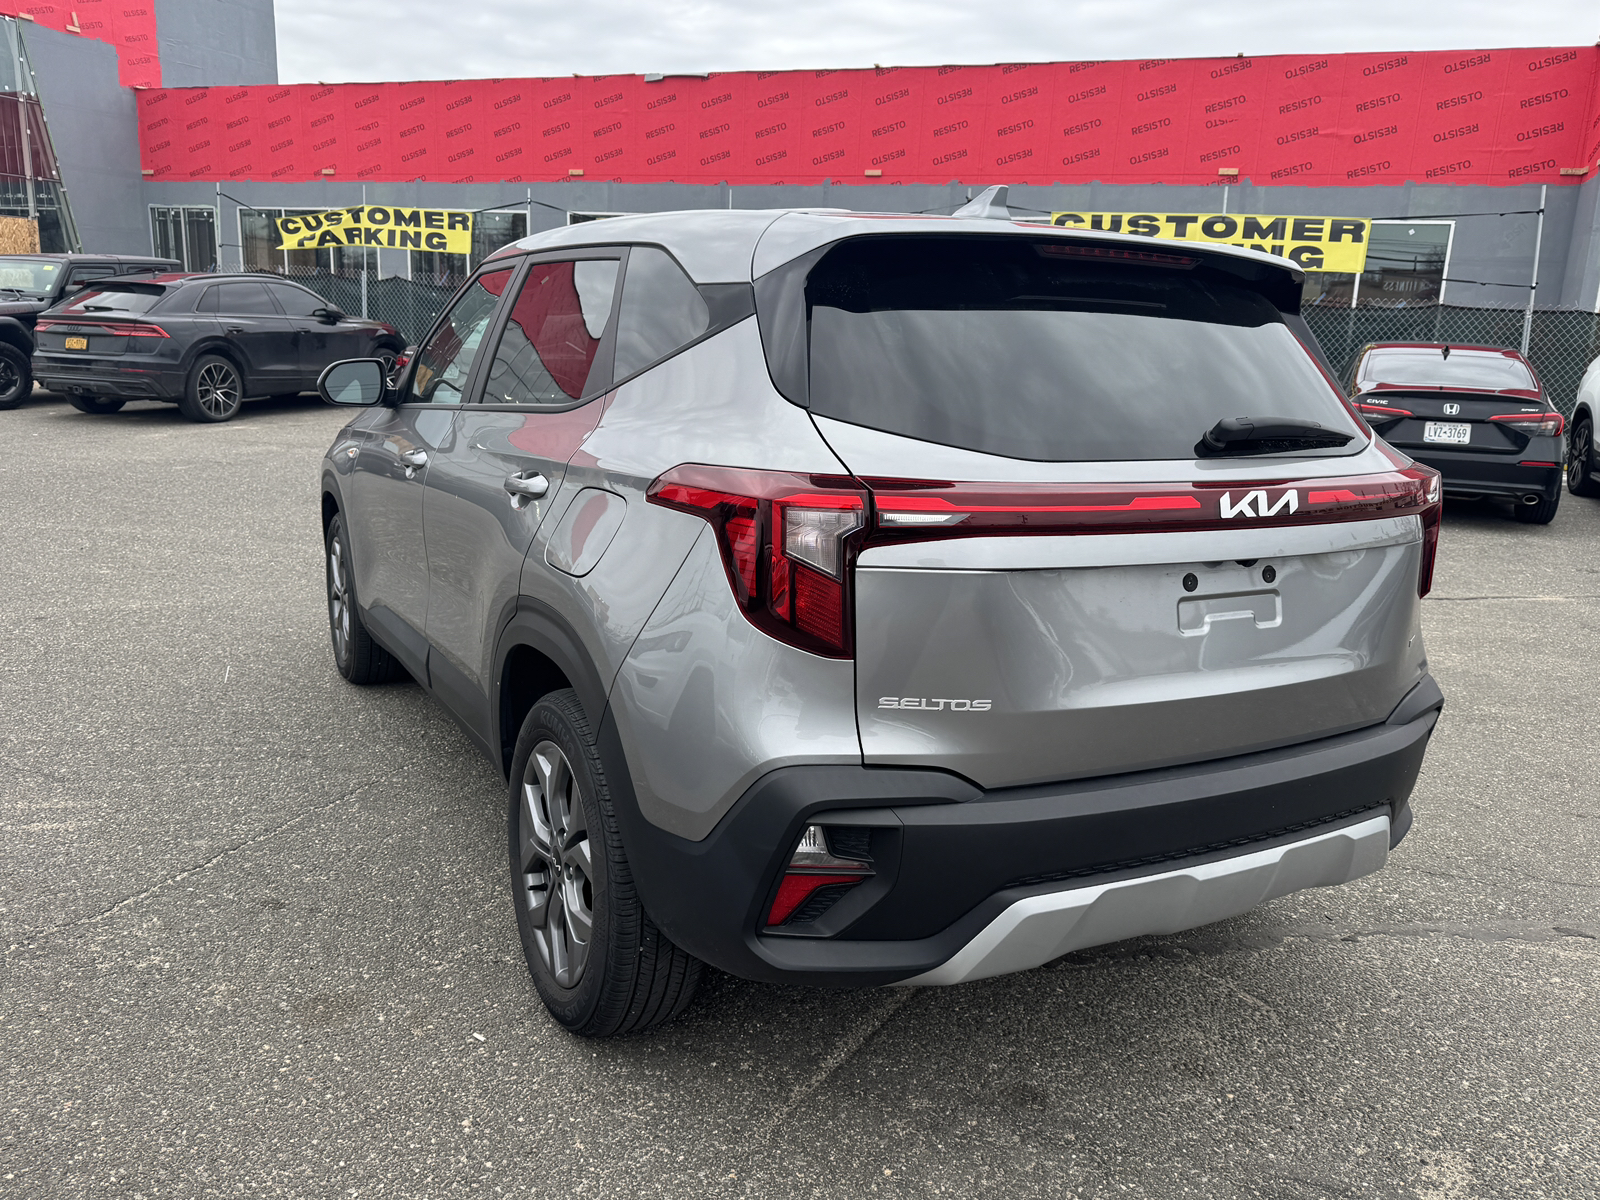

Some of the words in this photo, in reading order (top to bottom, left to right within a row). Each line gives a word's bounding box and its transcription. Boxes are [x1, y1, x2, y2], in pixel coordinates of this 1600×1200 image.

[27, 6, 54, 15] RESISTO
[124, 9, 147, 18] RESISTO
[125, 34, 149, 43] RESISTO
[128, 58, 151, 66] RESISTO
[1363, 57, 1408, 76] RESISTO
[1444, 54, 1490, 74] RESISTO
[1528, 51, 1577, 71] RESISTO
[1210, 59, 1252, 79] RESISTO
[1286, 60, 1328, 79] RESISTO
[146, 93, 168, 106] RESISTO
[186, 92, 208, 106] RESISTO
[226, 91, 248, 104] RESISTO
[267, 89, 291, 104] RESISTO
[310, 88, 334, 101] RESISTO
[758, 92, 789, 108] RESISTO
[816, 90, 848, 106] RESISTO
[876, 89, 909, 106] RESISTO
[938, 88, 972, 104] RESISTO
[1002, 88, 1038, 104] RESISTO
[1069, 86, 1106, 103] RESISTO
[1138, 84, 1176, 101] RESISTO
[1520, 89, 1568, 108] RESISTO
[354, 94, 380, 109] RESISTO
[400, 96, 425, 111] RESISTO
[446, 95, 472, 110] RESISTO
[495, 95, 520, 109] RESISTO
[544, 94, 571, 108] RESISTO
[595, 94, 622, 108] RESISTO
[648, 94, 676, 109] RESISTO
[702, 94, 731, 109] RESISTO
[1206, 96, 1246, 113] RESISTO
[1280, 96, 1321, 114] RESISTO
[1356, 94, 1400, 112] RESISTO
[1437, 92, 1482, 110] RESISTO
[147, 118, 169, 131] RESISTO
[186, 117, 208, 131] RESISTO
[226, 116, 249, 130] RESISTO
[268, 115, 292, 130] RESISTO
[310, 113, 335, 128] RESISTO
[998, 120, 1034, 136] RESISTO
[1064, 119, 1101, 136] RESISTO
[1132, 118, 1170, 135] RESISTO
[400, 123, 425, 138] RESISTO
[446, 123, 472, 138] RESISTO
[494, 123, 520, 137] RESISTO
[543, 122, 570, 137] RESISTO
[594, 122, 621, 137] RESISTO
[646, 124, 674, 138] RESISTO
[700, 124, 730, 138] RESISTO
[756, 123, 786, 138] RESISTO
[813, 122, 844, 137] RESISTO
[872, 121, 905, 136] RESISTO
[934, 121, 968, 136] RESISTO
[1277, 127, 1318, 145] RESISTO
[1354, 126, 1398, 144] RESISTO
[1434, 124, 1479, 142] RESISTO
[1517, 122, 1564, 142] RESISTO
[150, 140, 171, 153] RESISTO
[189, 140, 211, 153] RESISTO
[229, 139, 252, 153] RESISTO
[270, 139, 294, 153] RESISTO
[313, 138, 337, 151] RESISTO
[357, 138, 382, 152] RESISTO
[401, 148, 427, 162] RESISTO
[448, 148, 474, 163] RESISTO
[496, 148, 522, 162] RESISTO
[544, 148, 572, 162] RESISTO
[595, 149, 622, 163] RESISTO
[647, 150, 676, 165] RESISTO
[701, 151, 730, 166] RESISTO
[756, 151, 787, 166] RESISTO
[813, 150, 845, 165] RESISTO
[872, 150, 905, 165] RESISTO
[933, 150, 967, 165] RESISTO
[997, 149, 1032, 166] RESISTO
[1063, 148, 1100, 165] RESISTO
[1130, 148, 1168, 164] RESISTO
[1200, 146, 1240, 162] RESISTO
[189, 165, 212, 178] RESISTO
[229, 165, 252, 178] RESISTO
[271, 164, 294, 178] RESISTO
[357, 164, 382, 178] RESISTO
[1271, 162, 1312, 180] RESISTO
[1347, 161, 1390, 179] RESISTO
[1426, 160, 1471, 178] RESISTO
[1509, 160, 1556, 178] RESISTO
[280, 207, 470, 232] CUSTOMER
[1054, 213, 1366, 243] CUSTOMER
[297, 228, 447, 250] PARKING
[1219, 489, 1299, 519] KIA
[877, 696, 992, 712] SELTOS
[540, 710, 575, 761] KUMHO
